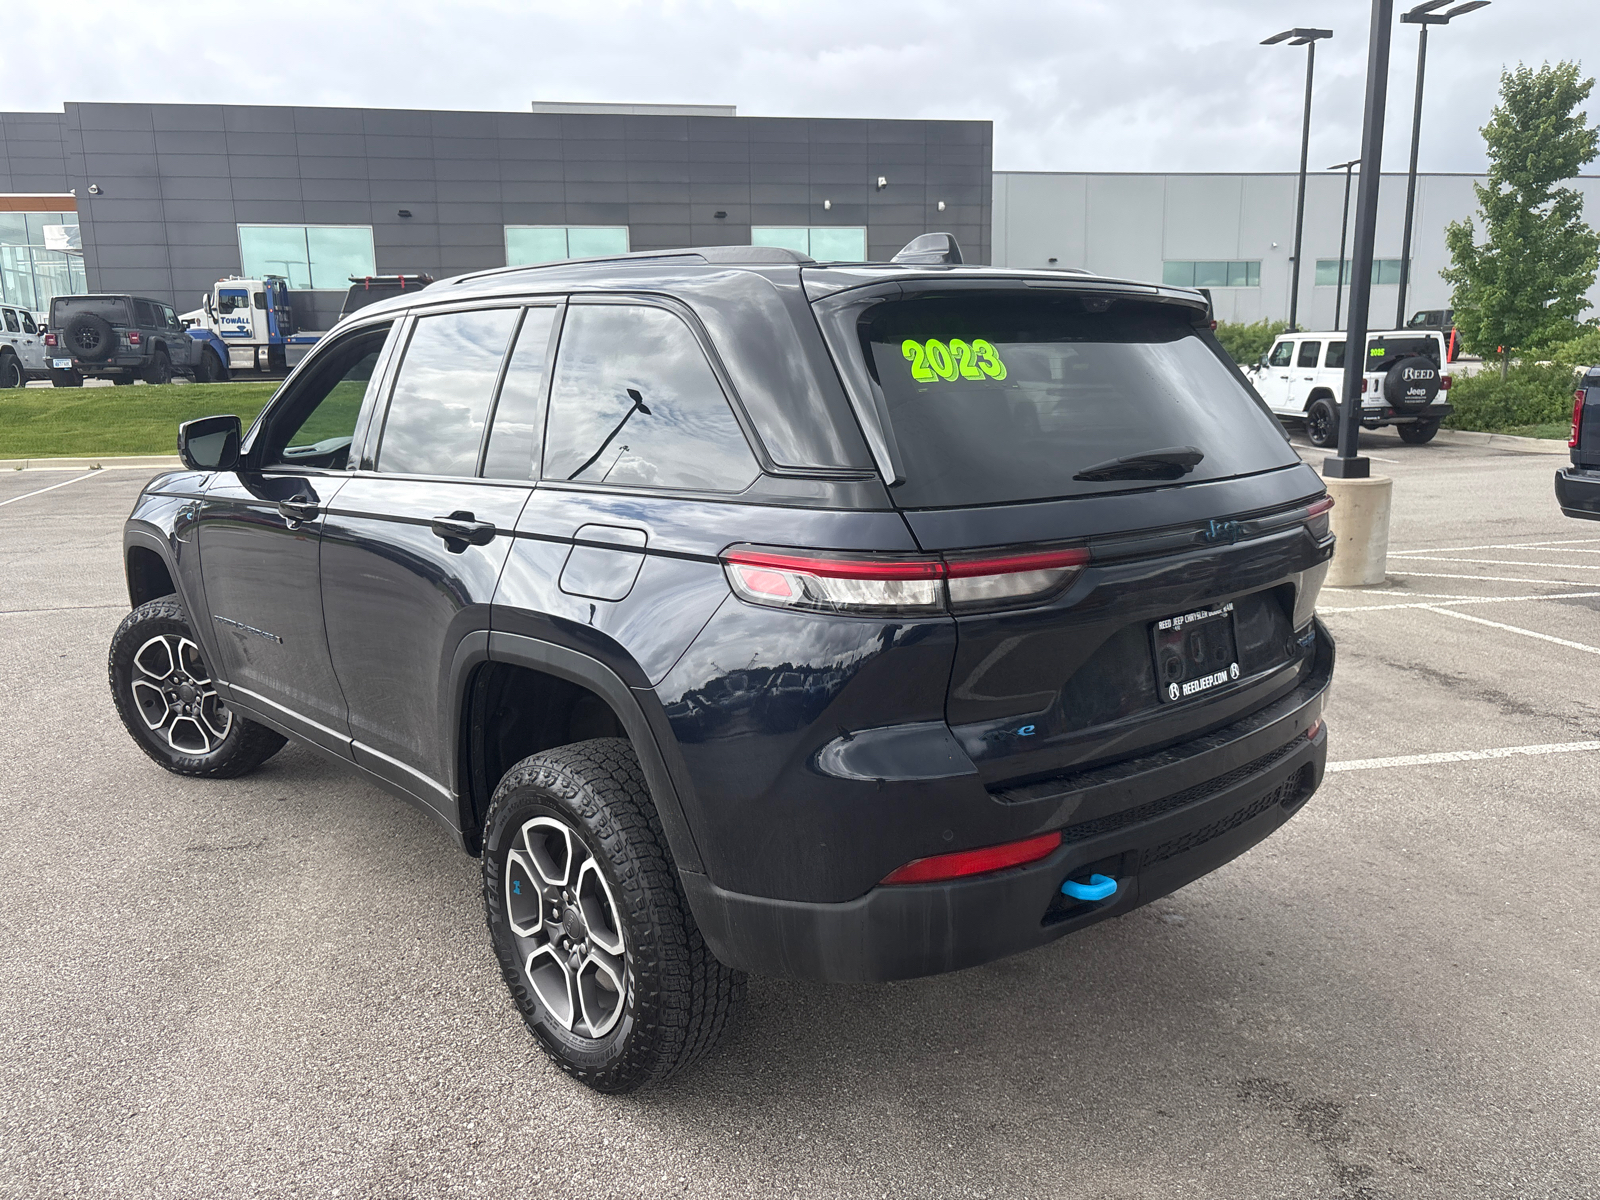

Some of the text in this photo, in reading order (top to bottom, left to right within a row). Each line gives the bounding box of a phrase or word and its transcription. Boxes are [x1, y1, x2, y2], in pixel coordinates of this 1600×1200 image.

[901, 338, 1007, 383] 2023
[1402, 367, 1435, 382] REED
[1406, 387, 1427, 396] Jeep
[1158, 619, 1172, 630] REED
[1182, 670, 1228, 696] REEDJEEP.COM
